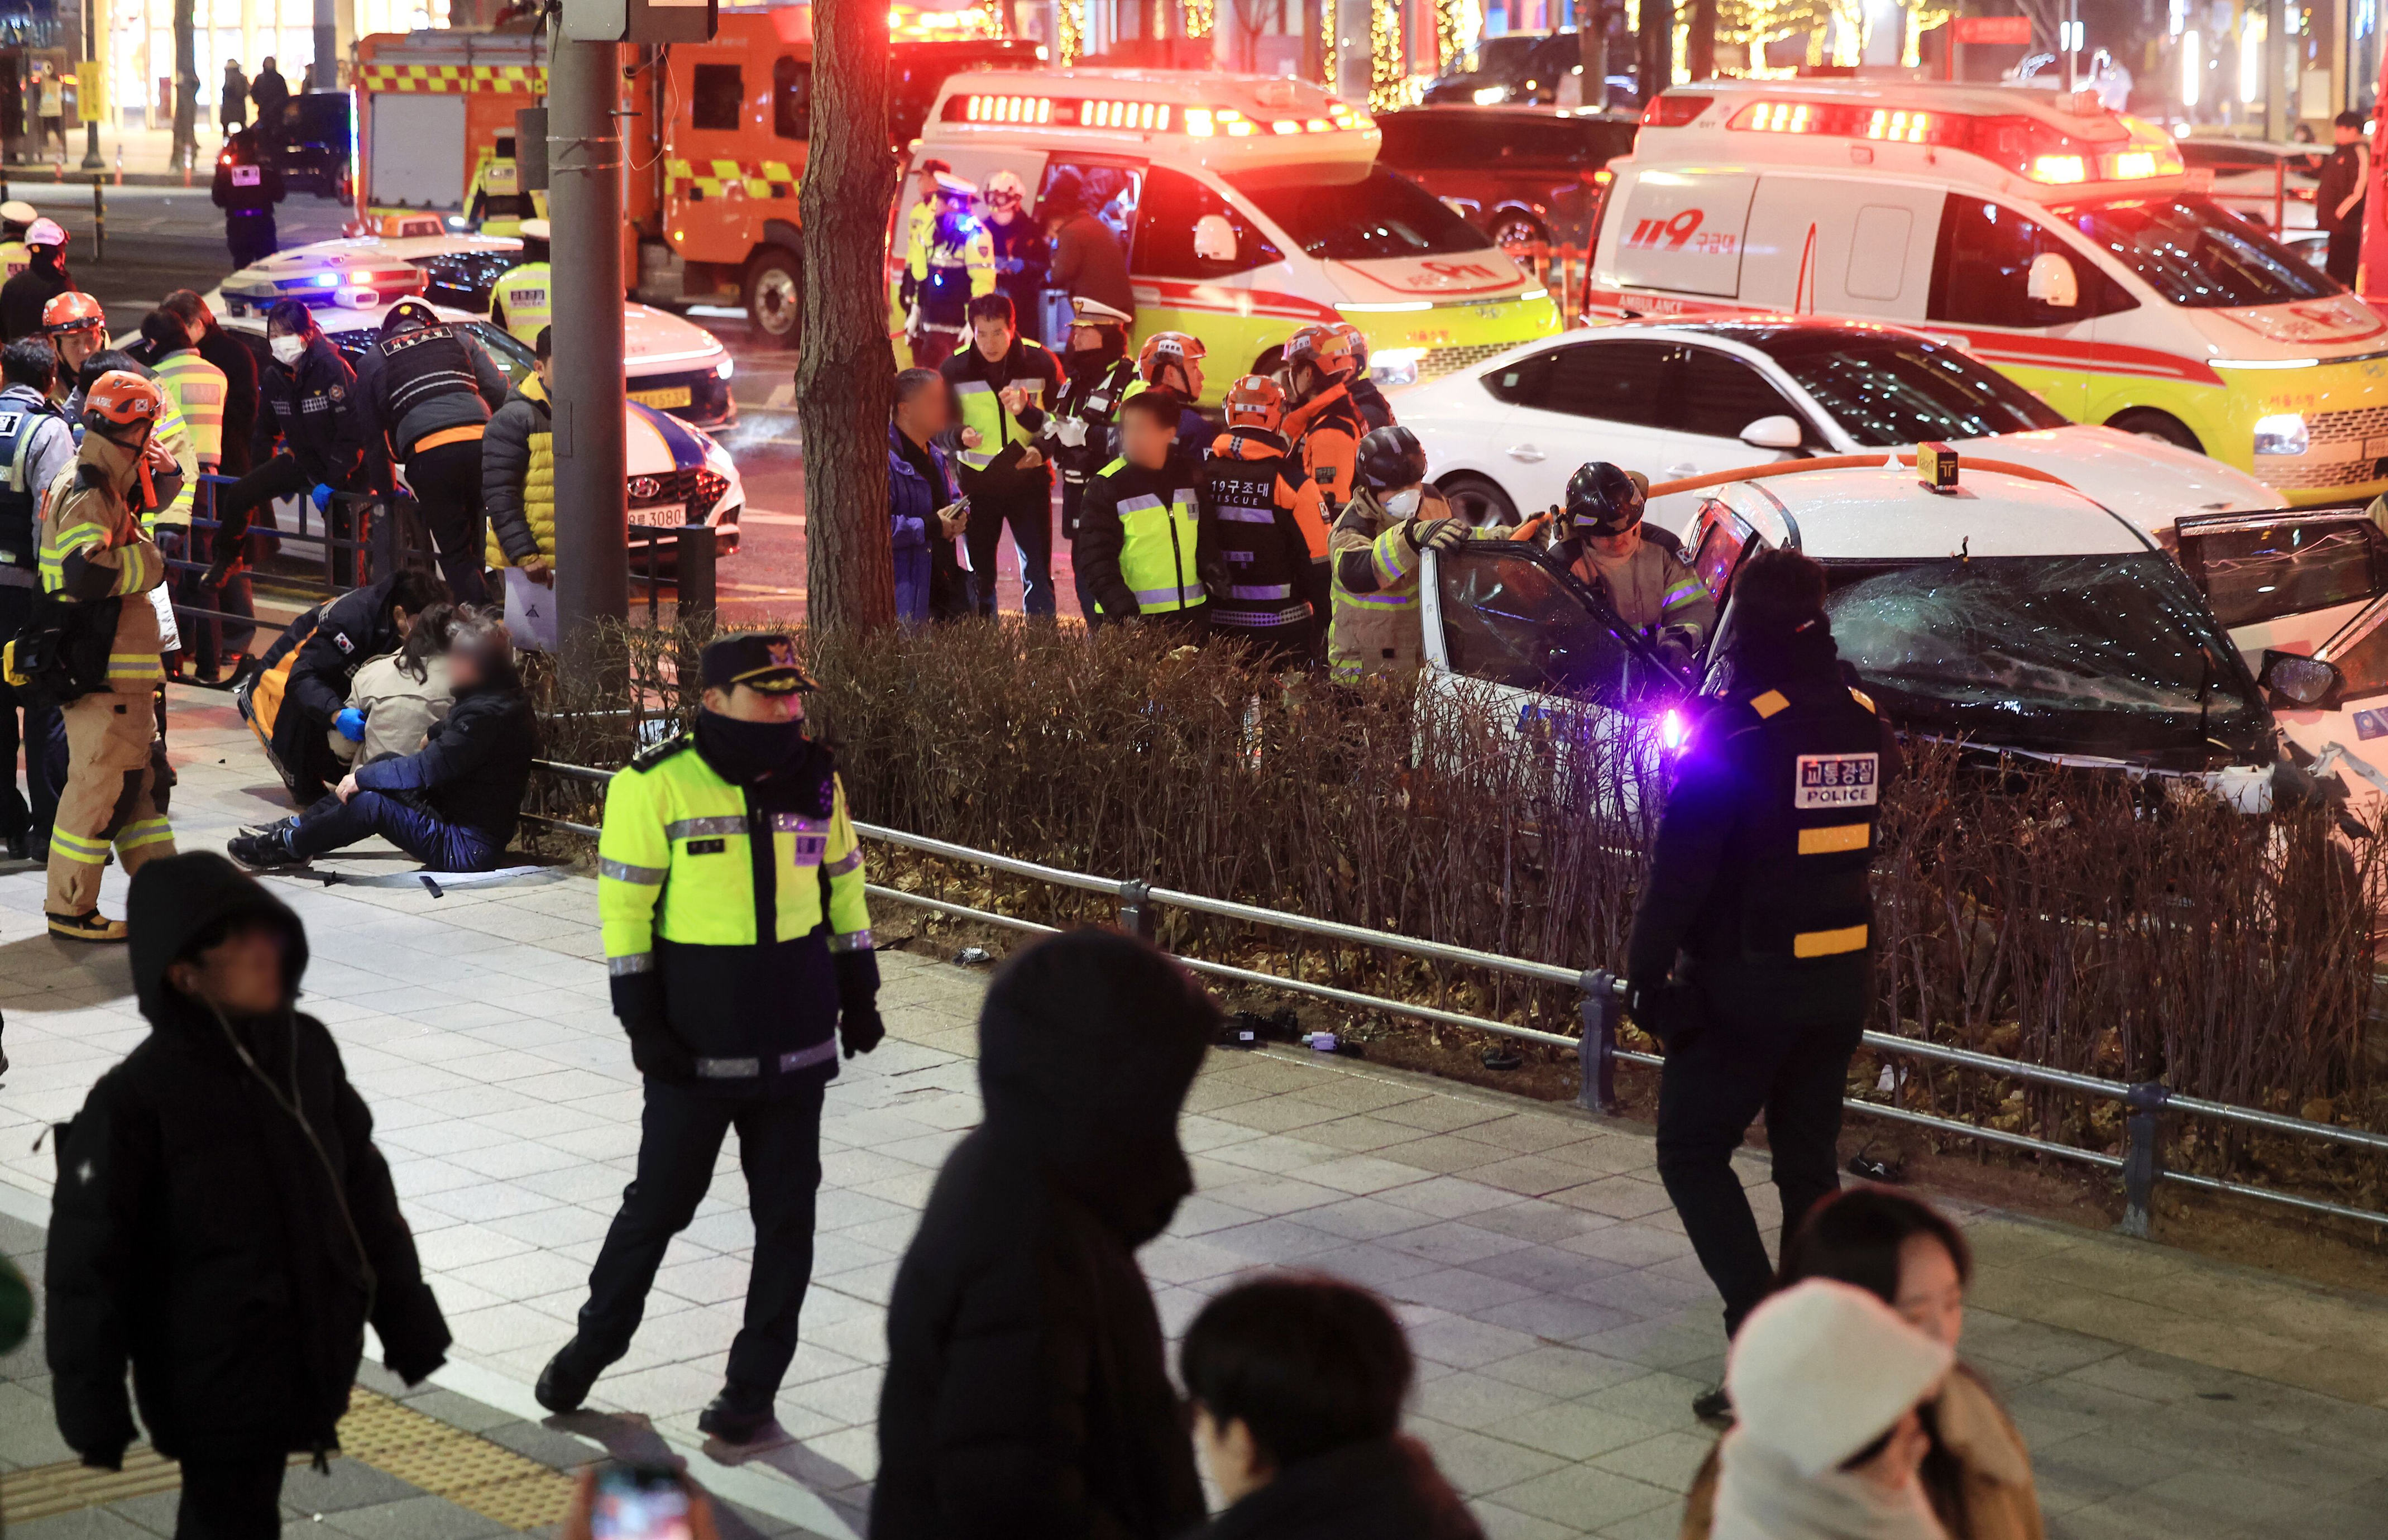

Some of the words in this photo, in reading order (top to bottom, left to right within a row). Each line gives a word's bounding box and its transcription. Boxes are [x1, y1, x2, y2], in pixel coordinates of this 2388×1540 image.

[1626, 208, 1705, 252] 119
[1697, 232, 1736, 255] 구급대
[1619, 294, 1683, 314] AMBULANCE
[650, 509, 681, 526] 3080
[1806, 760, 1872, 785] 교통경찰
[1807, 789, 1868, 802] POLICE
